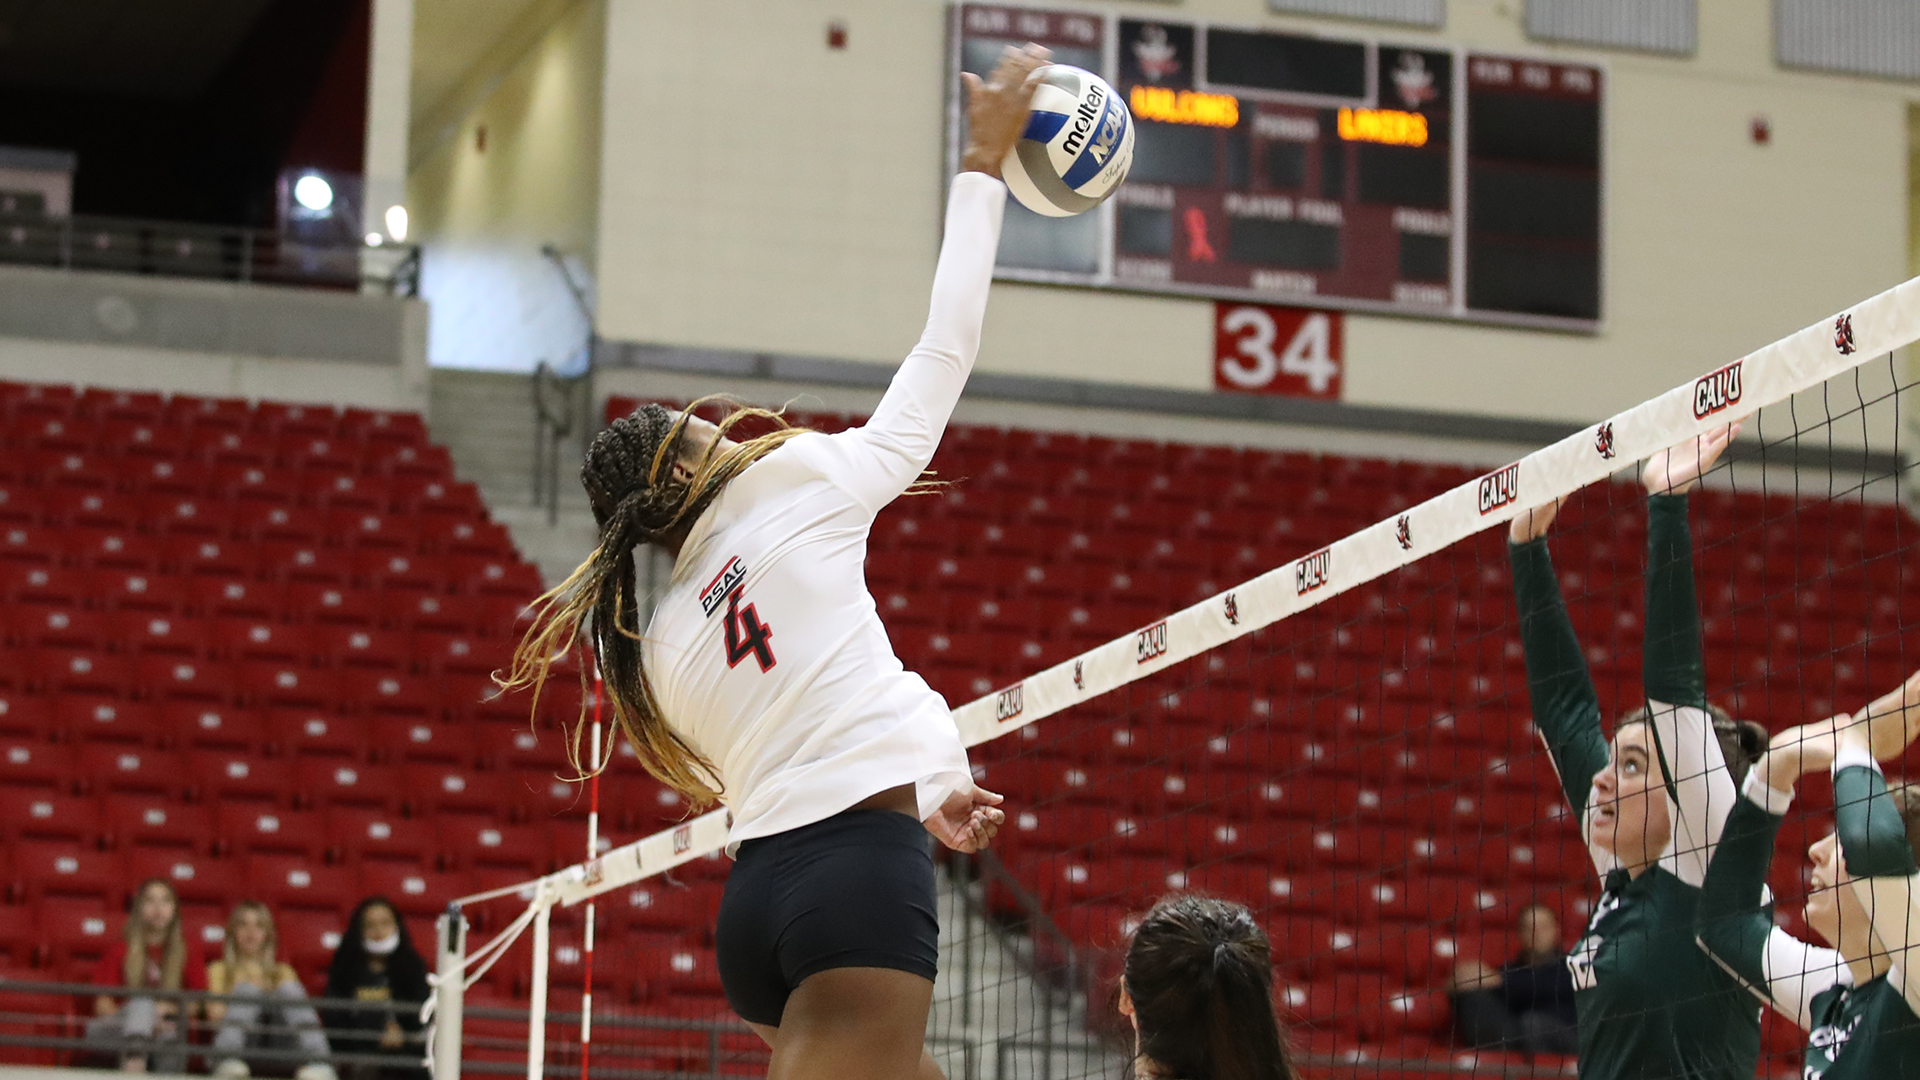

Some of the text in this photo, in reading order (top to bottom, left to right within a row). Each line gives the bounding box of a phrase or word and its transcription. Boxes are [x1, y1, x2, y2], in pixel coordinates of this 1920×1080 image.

[1063, 84, 1104, 156] molten
[1089, 101, 1125, 167] NCAA
[1220, 306, 1338, 393] 34
[702, 558, 747, 612] PSAC
[723, 584, 777, 674] 4
